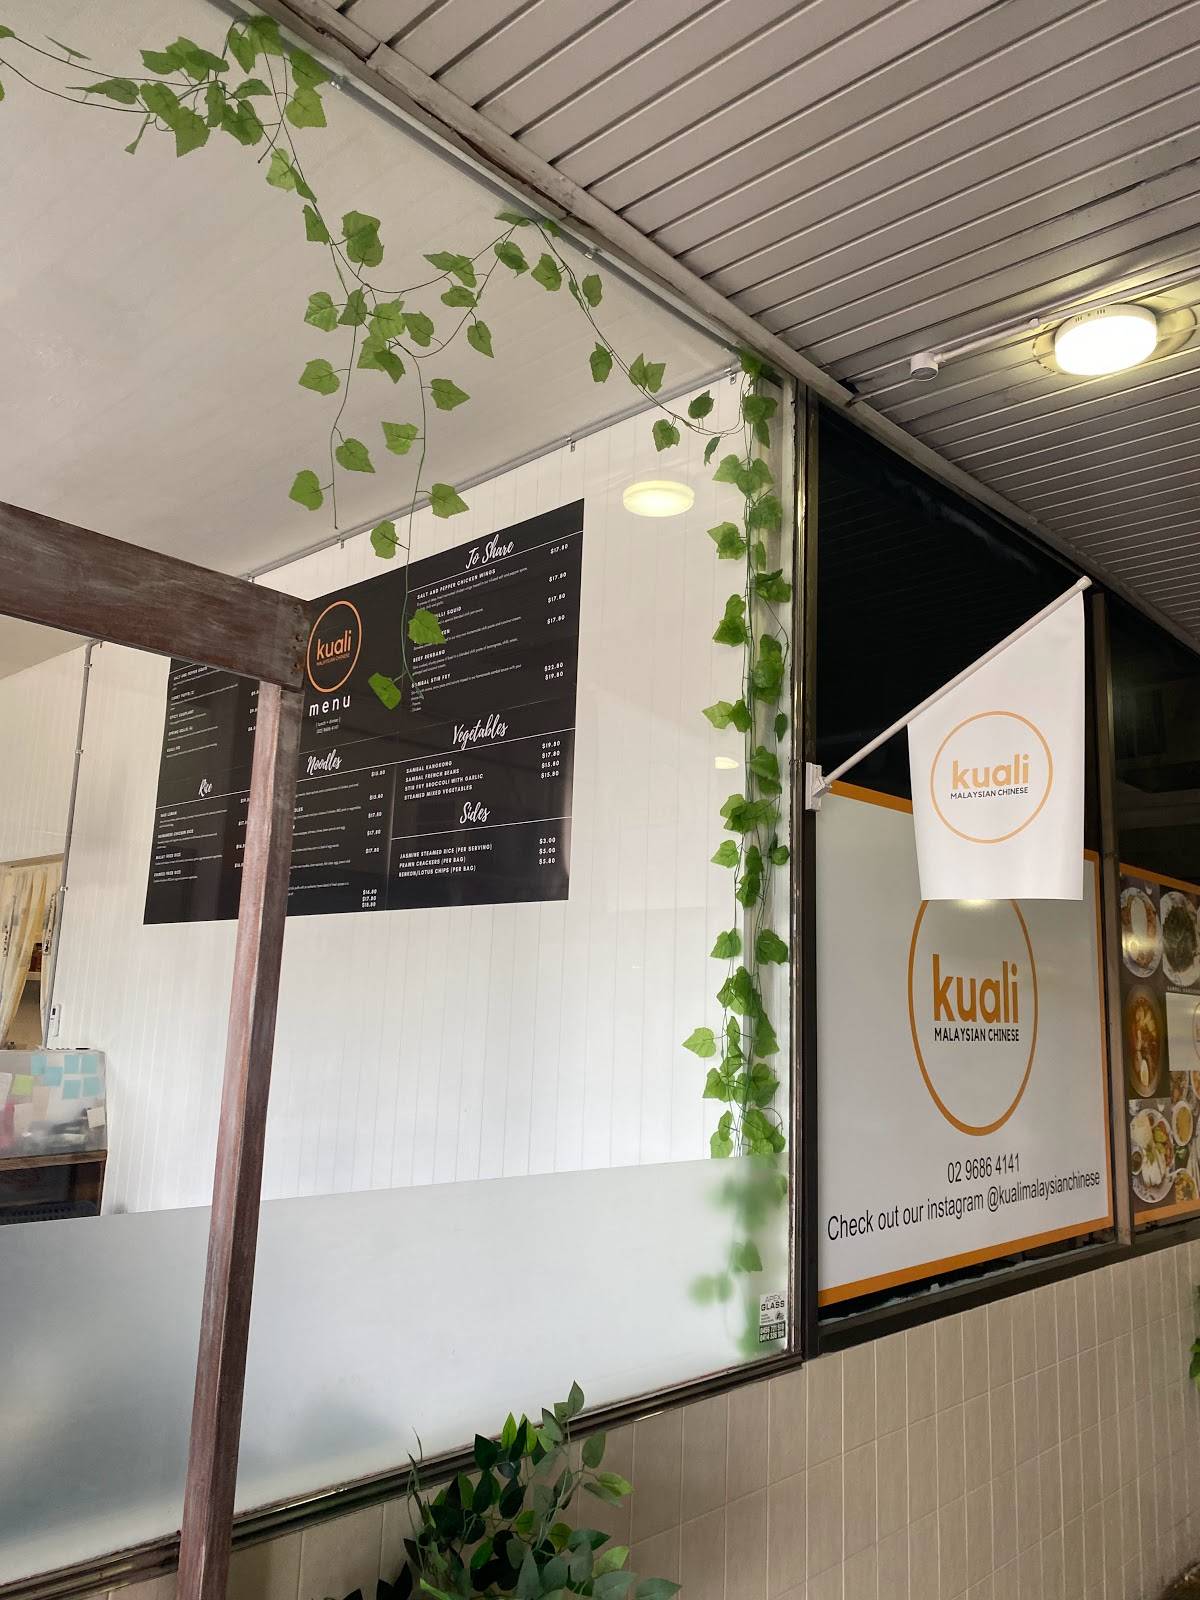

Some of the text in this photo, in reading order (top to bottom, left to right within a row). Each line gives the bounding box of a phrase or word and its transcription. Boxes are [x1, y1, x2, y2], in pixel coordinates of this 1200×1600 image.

[465, 534, 515, 569] To Share
[417, 591, 429, 600] SALT
[430, 588, 439, 596] AND
[439, 582, 456, 592] PEPPER
[456, 574, 478, 586] CHICKEN
[479, 568, 496, 578] WINGS
[446, 606, 462, 616] SQUID
[316, 629, 352, 661] kuali
[412, 655, 424, 663] BEEF
[424, 649, 446, 660] RENDANG
[309, 695, 351, 717] menu
[453, 714, 509, 750] Vegetables
[306, 749, 342, 776] Noodles
[406, 765, 424, 774] SAMBAL
[952, 753, 1030, 790] kuali
[404, 784, 415, 792] STIR
[426, 778, 450, 788] BROCCOLI
[464, 773, 484, 781] GARLIC
[405, 768, 460, 783] SAMBAL FRENCH BEANS
[404, 784, 473, 801] STEAMED MIXED VEGETABLES
[950, 786, 1029, 800] MALAYSIAN CHINESE
[459, 801, 491, 824] Sides
[400, 851, 420, 860] JASMINE
[420, 849, 442, 857] STEAMED
[468, 843, 493, 852] SERVING)
[416, 859, 440, 867] CRACKERS
[933, 953, 1019, 1024] kuali
[934, 1027, 1020, 1042] MALAYSIAN CHINESE
[947, 1153, 1020, 1184] 02 9686 4141
[827, 1170, 1101, 1241] Check out our instagram @kualimalaysianchinese
[761, 1300, 785, 1311] GLASS
